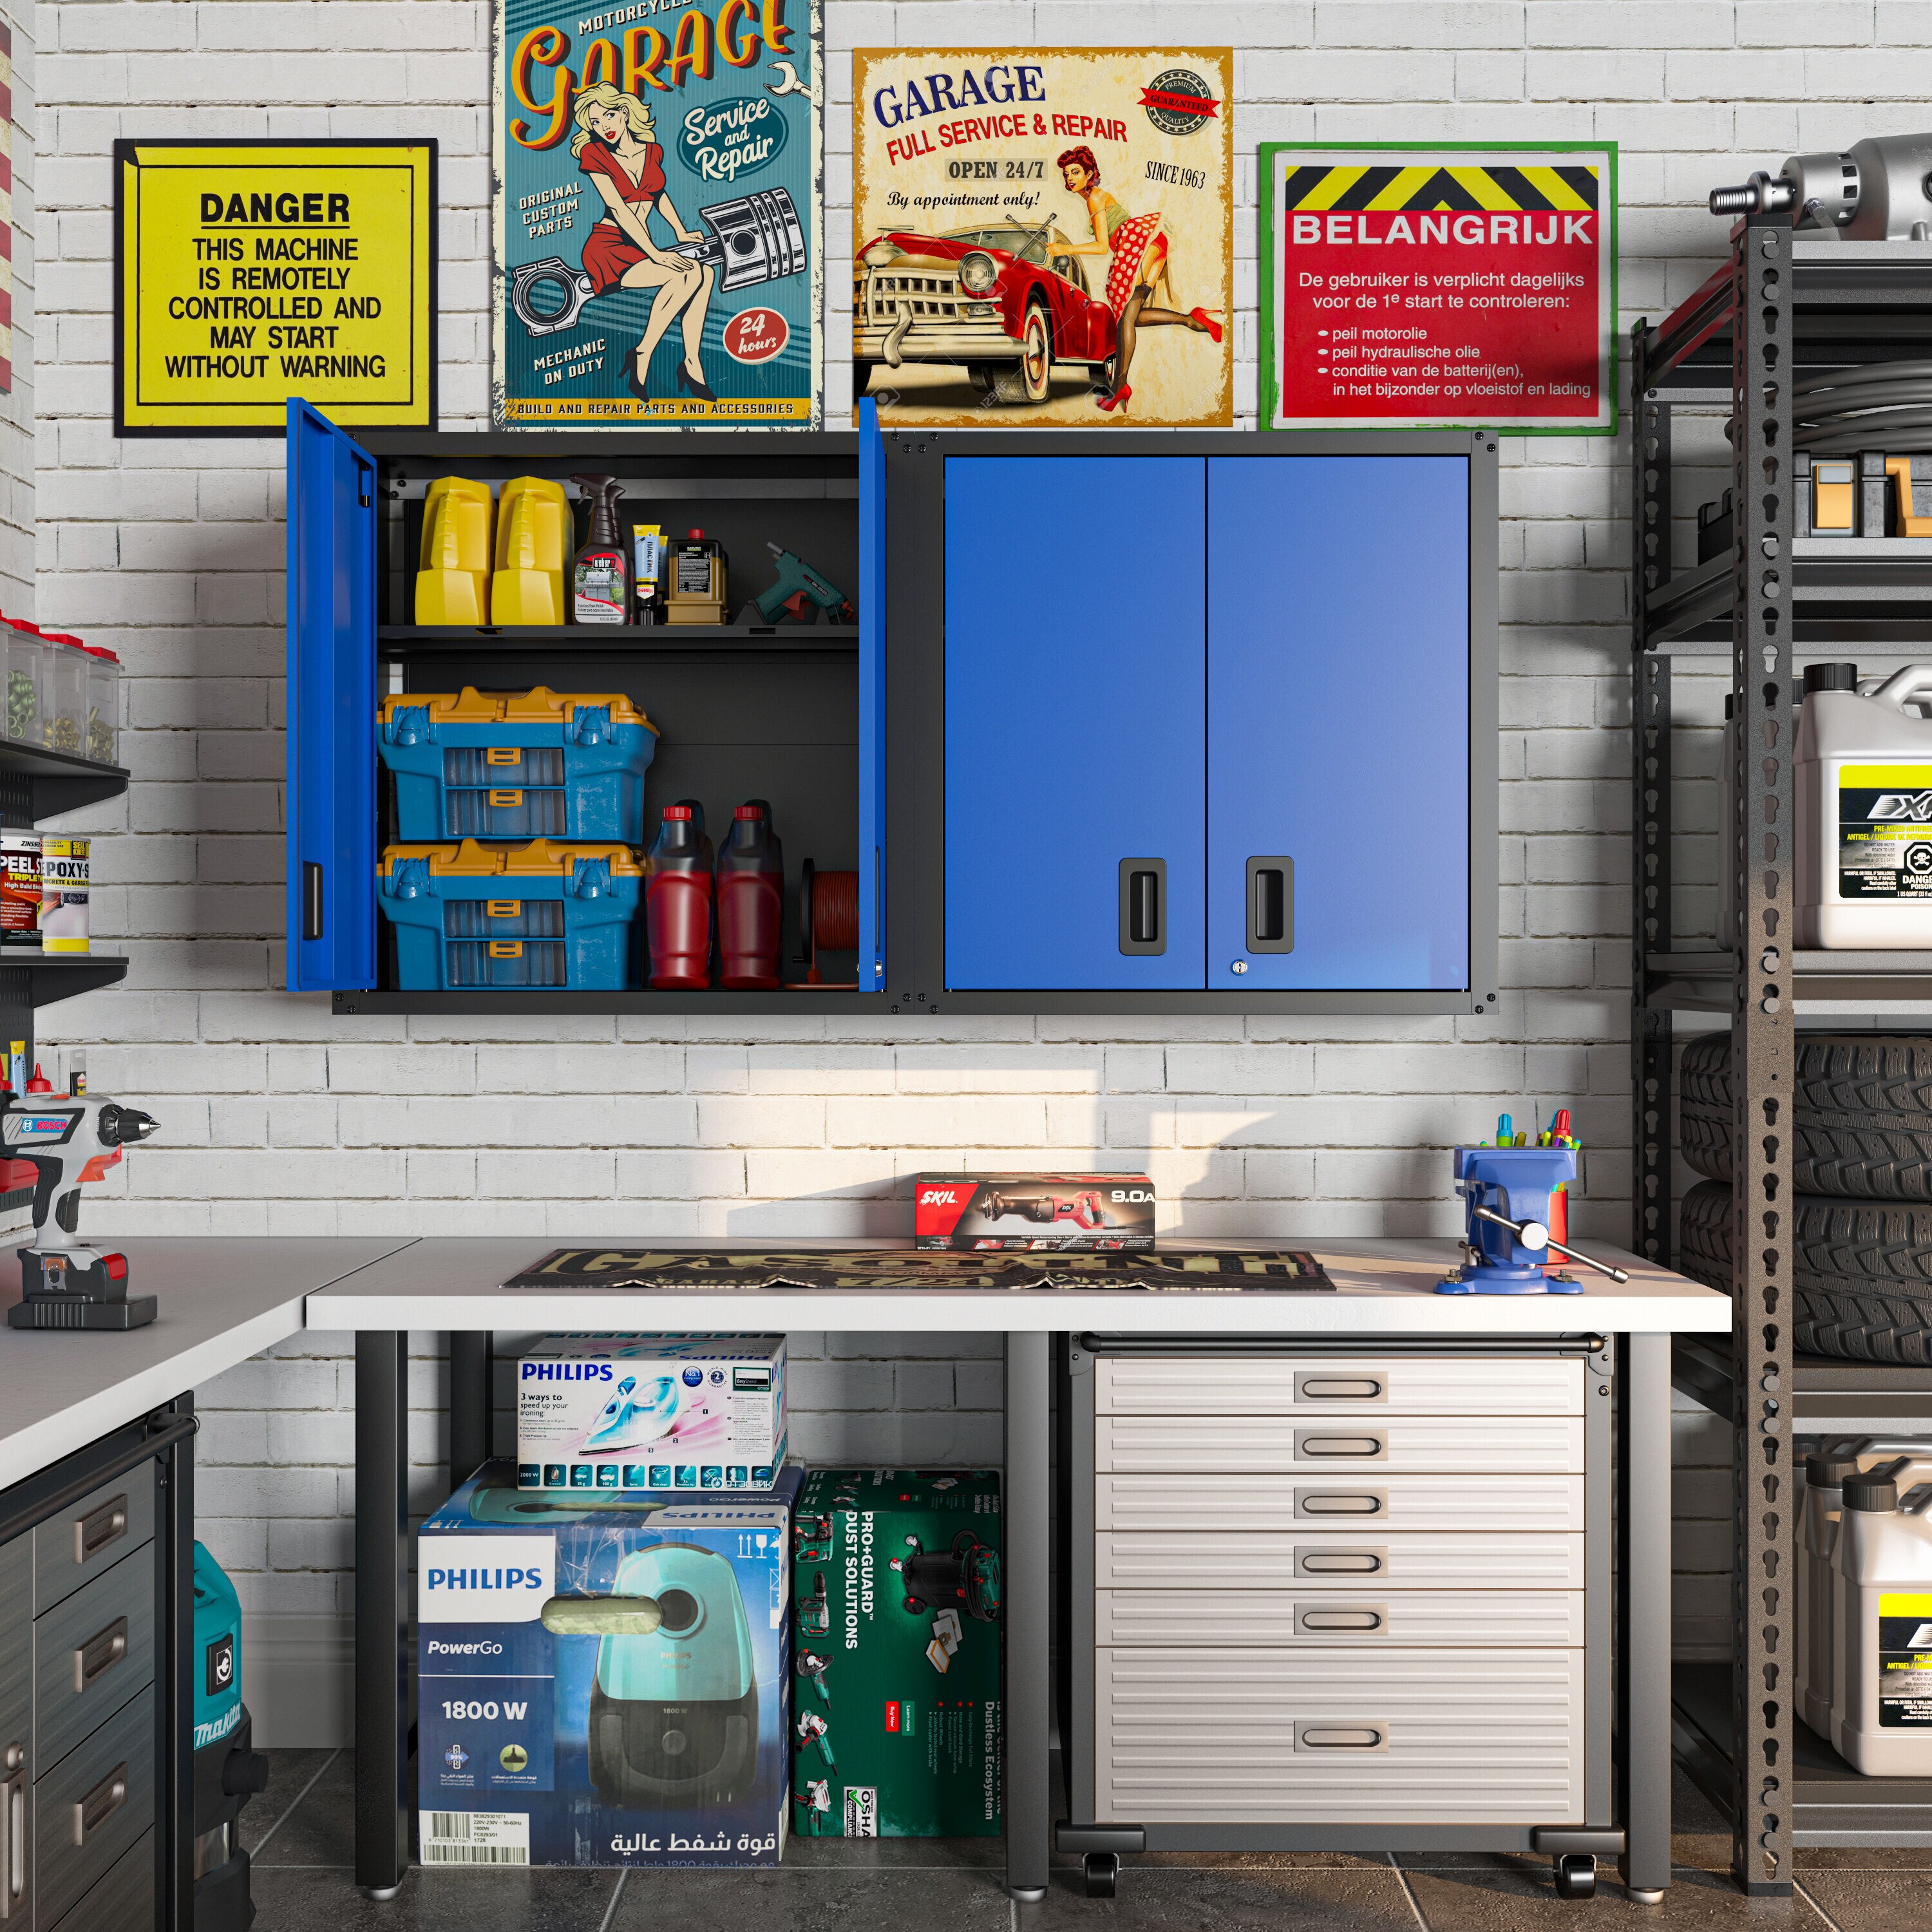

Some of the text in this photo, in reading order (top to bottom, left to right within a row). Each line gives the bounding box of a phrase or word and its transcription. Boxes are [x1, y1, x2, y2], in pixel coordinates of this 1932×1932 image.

[509, 0, 795, 151] GARAGE
[1165, 80, 1197, 93] PREMIUM
[873, 66, 1046, 128] GARAGE
[1150, 95, 1208, 111] GUARANTEED
[685, 99, 770, 146] Service
[1161, 112, 1189, 124] QUALITY
[724, 124, 750, 146] and
[886, 113, 1127, 166] FULL SERVICE & REPAIR
[695, 135, 773, 181] Repair
[949, 161, 1044, 179] OPEN 24/7
[1145, 161, 1206, 189] SINCE 1963
[519, 182, 583, 210] ORIGINAL
[887, 192, 1040, 210] By appointment only!
[200, 193, 350, 223] DANGER
[523, 198, 579, 225] CUSTOM
[529, 216, 573, 239] PARTS
[1293, 215, 1593, 244] BELANGRIJK
[192, 238, 358, 260] THIS MACHINE
[199, 267, 350, 290] IS REMOTELY
[1299, 273, 1584, 290] De gebruiker is verplicht dagelijks
[169, 297, 381, 319] CONTROLLED AND
[1312, 296, 1351, 308] voor
[1356, 295, 1377, 308] de
[1405, 296, 1443, 308] start
[1448, 296, 1464, 308] te
[1469, 295, 1569, 308] controleren:
[740, 313, 766, 335] 24
[1332, 328, 1427, 342] peil motorolie
[211, 326, 339, 348] MAY START
[737, 336, 777, 355] hours
[534, 338, 605, 371] MECHANIC
[1332, 346, 1480, 361] peil hydraulische olie
[165, 355, 385, 378] WITHOUT WARNING
[544, 357, 604, 385] ON DUTY
[1332, 365, 1524, 380] conditie van de batterij(en),
[1333, 384, 1591, 399] in het bijzonder op vloeistof en lading
[518, 404, 793, 415] BUILD AND REPAIR PARTS AND ACCESSORIES
[594, 558, 611, 567] weber
[8, 873, 37, 882] TRIPLE
[37, 1121, 67, 1130] BOSCH
[1111, 1190, 1155, 1202] 9.0A
[522, 1363, 613, 1381] PHILIPS
[662, 1511, 776, 1520] PHILIPS
[428, 1567, 542, 1590] PHILIPS
[845, 1511, 859, 1649] DUST SOLUTIONS
[428, 1641, 503, 1656] PowerGo
[442, 1700, 528, 1721] 1800 W
[194, 1702, 241, 1748] makita
[983, 1701, 995, 1820] Dustless Ecosystem
[862, 1790, 871, 1837] OSHA
[611, 1831, 775, 1856] قوة شفط عالية
